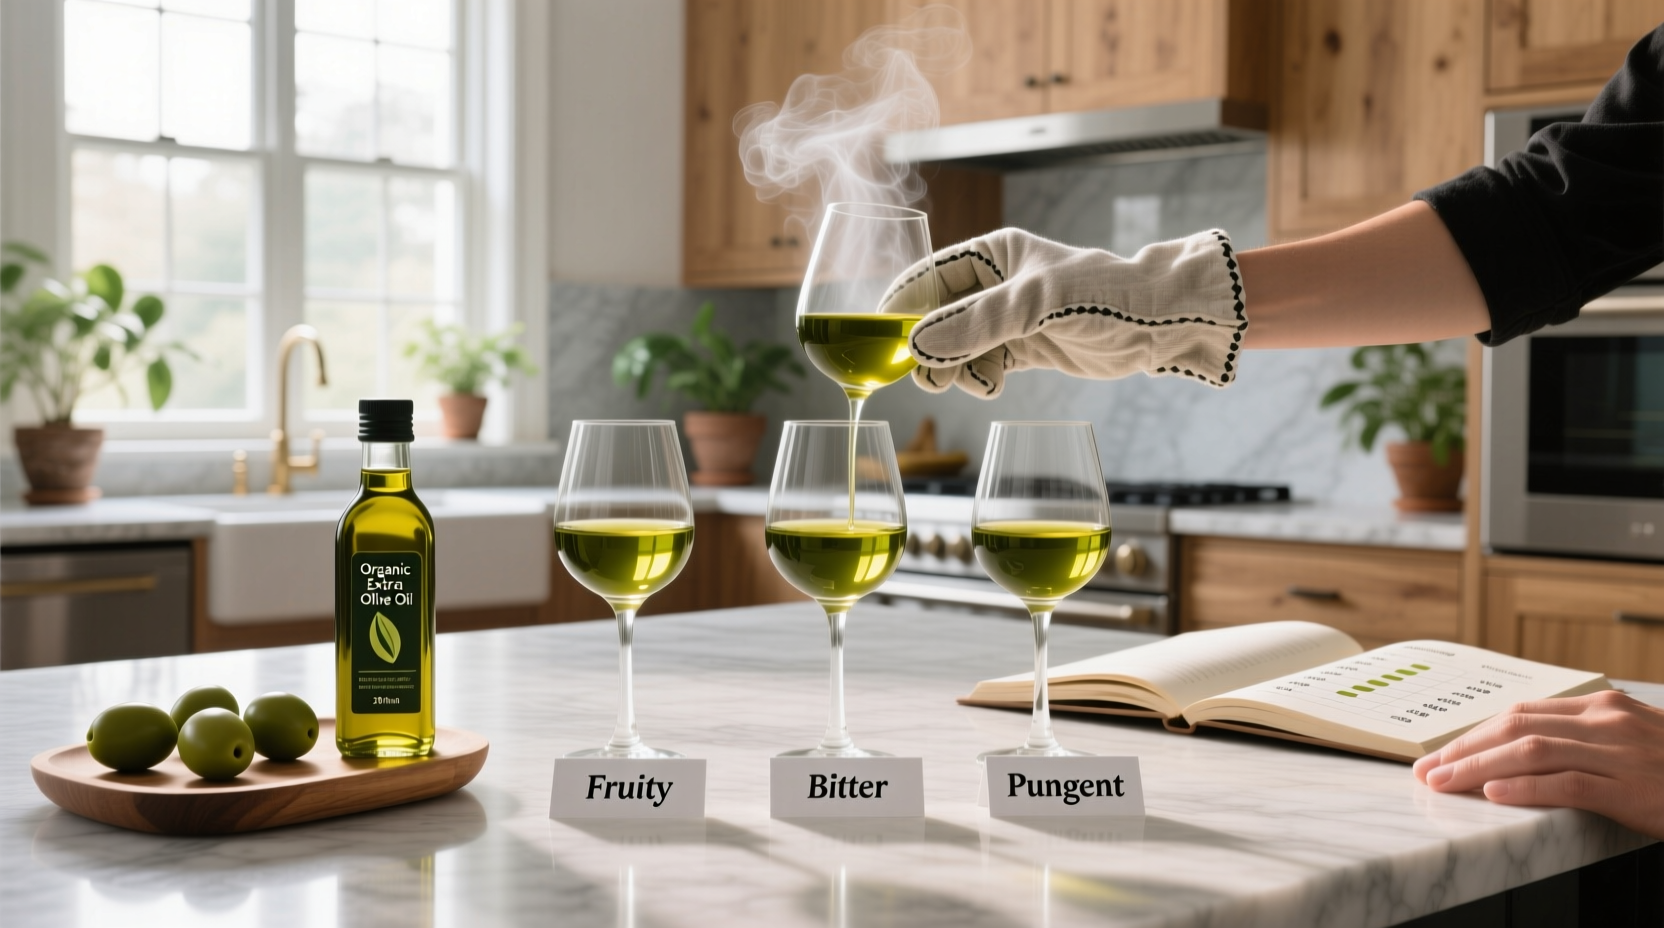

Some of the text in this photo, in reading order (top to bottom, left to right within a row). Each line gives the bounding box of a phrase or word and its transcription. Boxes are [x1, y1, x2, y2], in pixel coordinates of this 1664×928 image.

[360, 562, 411, 578] Organic
[367, 578, 403, 591] Extra
[394, 592, 413, 606] Oil
[585, 774, 674, 808] Fruity
[807, 773, 889, 799] Bitter
[1007, 772, 1125, 806] Pungent
